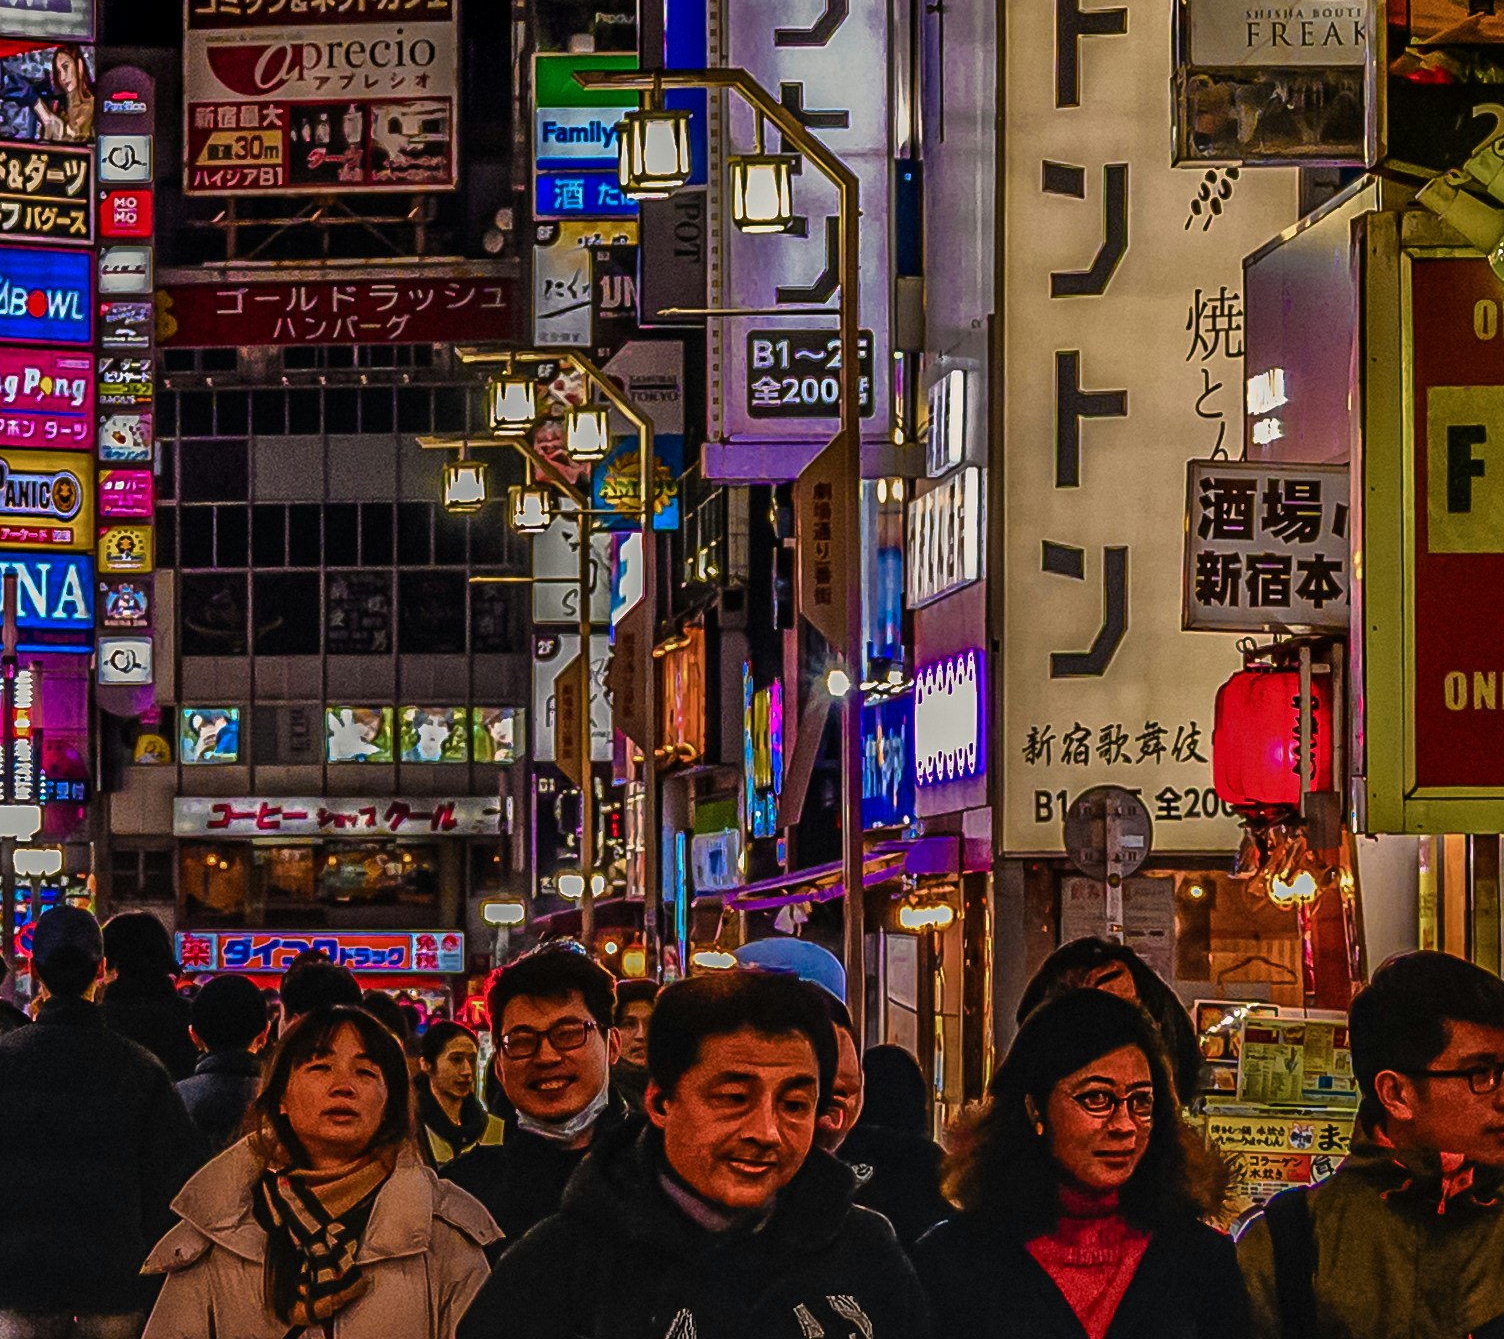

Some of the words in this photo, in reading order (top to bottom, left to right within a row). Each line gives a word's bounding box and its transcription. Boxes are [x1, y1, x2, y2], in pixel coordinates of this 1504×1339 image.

[1246, 7, 1306, 21] SHISHA
[253, 27, 436, 90] aprecio
[313, 72, 431, 91] アプレシオ
[194, 103, 284, 130] 新宿最大
[193, 166, 284, 186] ハイジアB1
[553, 179, 584, 210] 酒
[215, 283, 509, 315] ゴールドラッシュ
[273, 314, 412, 340] ハンバーグ
[23, 366, 87, 407] Pong
[206, 801, 308, 830] コーヒー
[384, 801, 458, 832] クール
